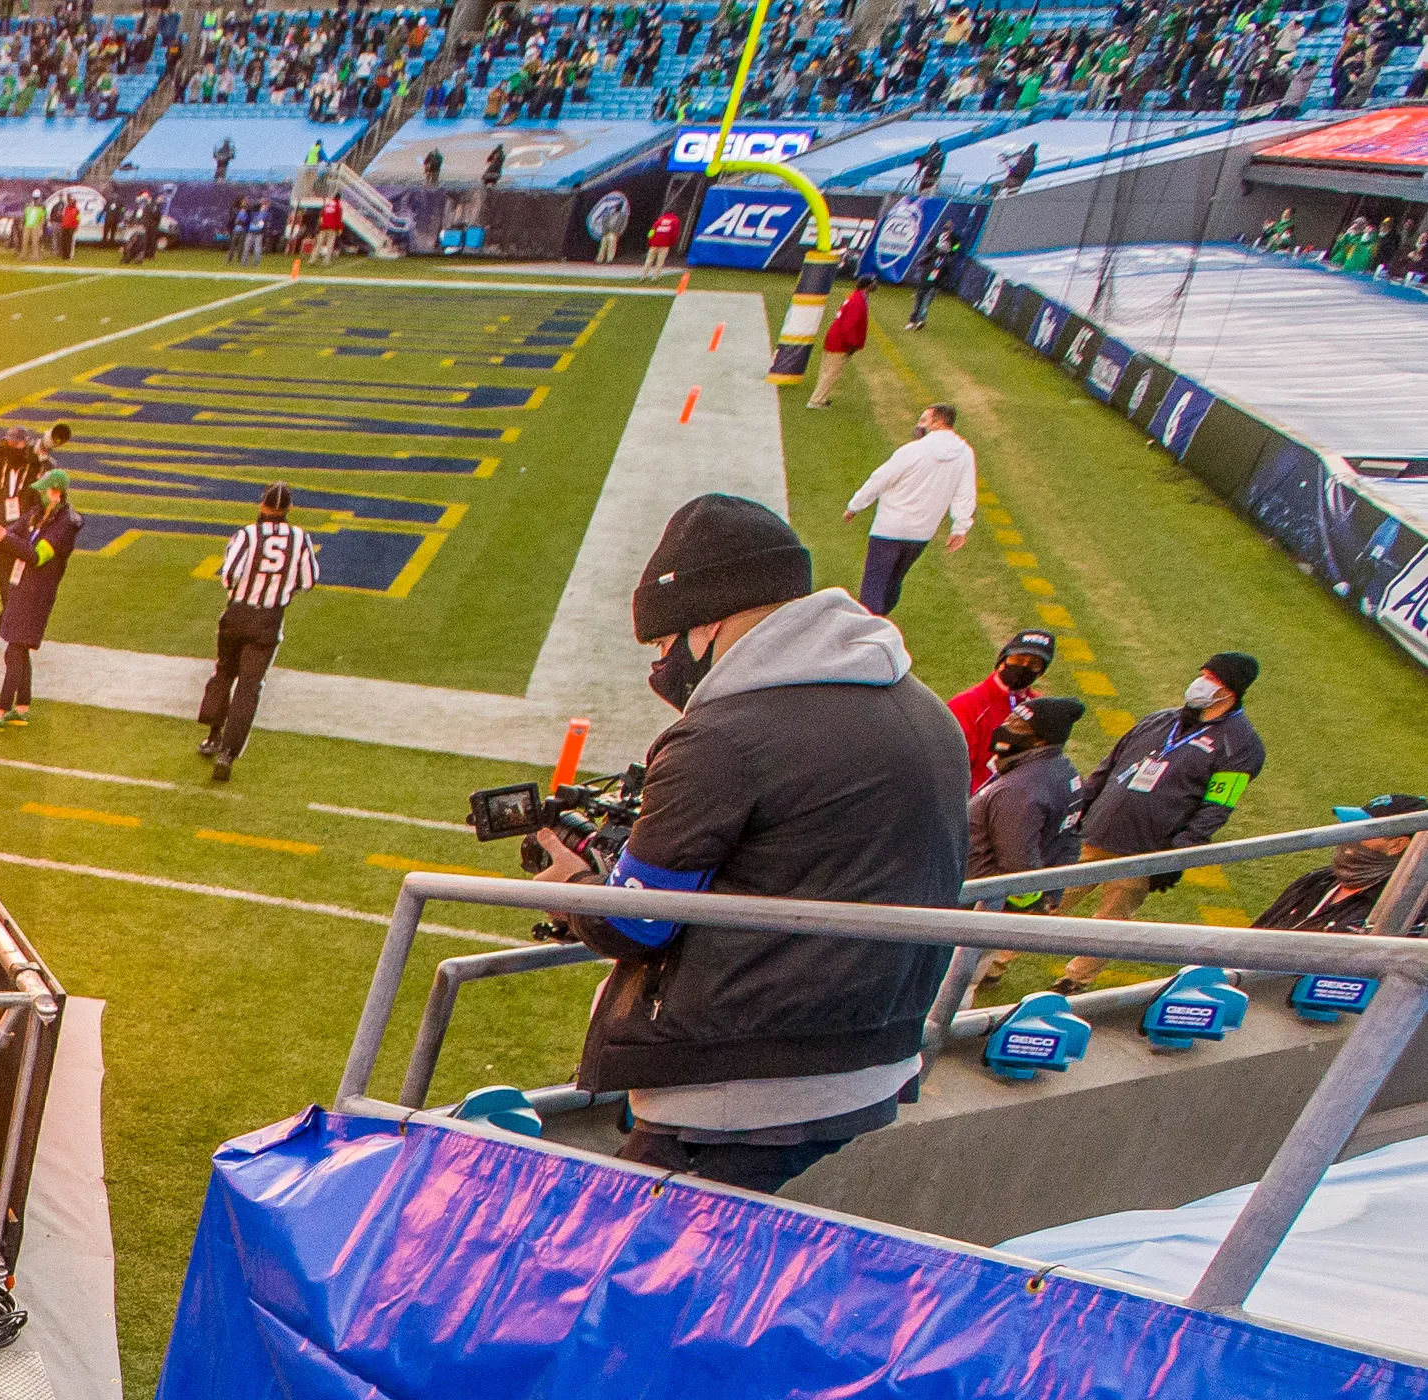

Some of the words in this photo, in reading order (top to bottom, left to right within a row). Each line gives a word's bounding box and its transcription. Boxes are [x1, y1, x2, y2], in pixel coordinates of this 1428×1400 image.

[675, 132, 812, 164] GEICO
[704, 203, 793, 239] ACC
[261, 535, 288, 574] S
[1165, 1005, 1215, 1018] GEICO
[1008, 1034, 1057, 1048] GEICO
